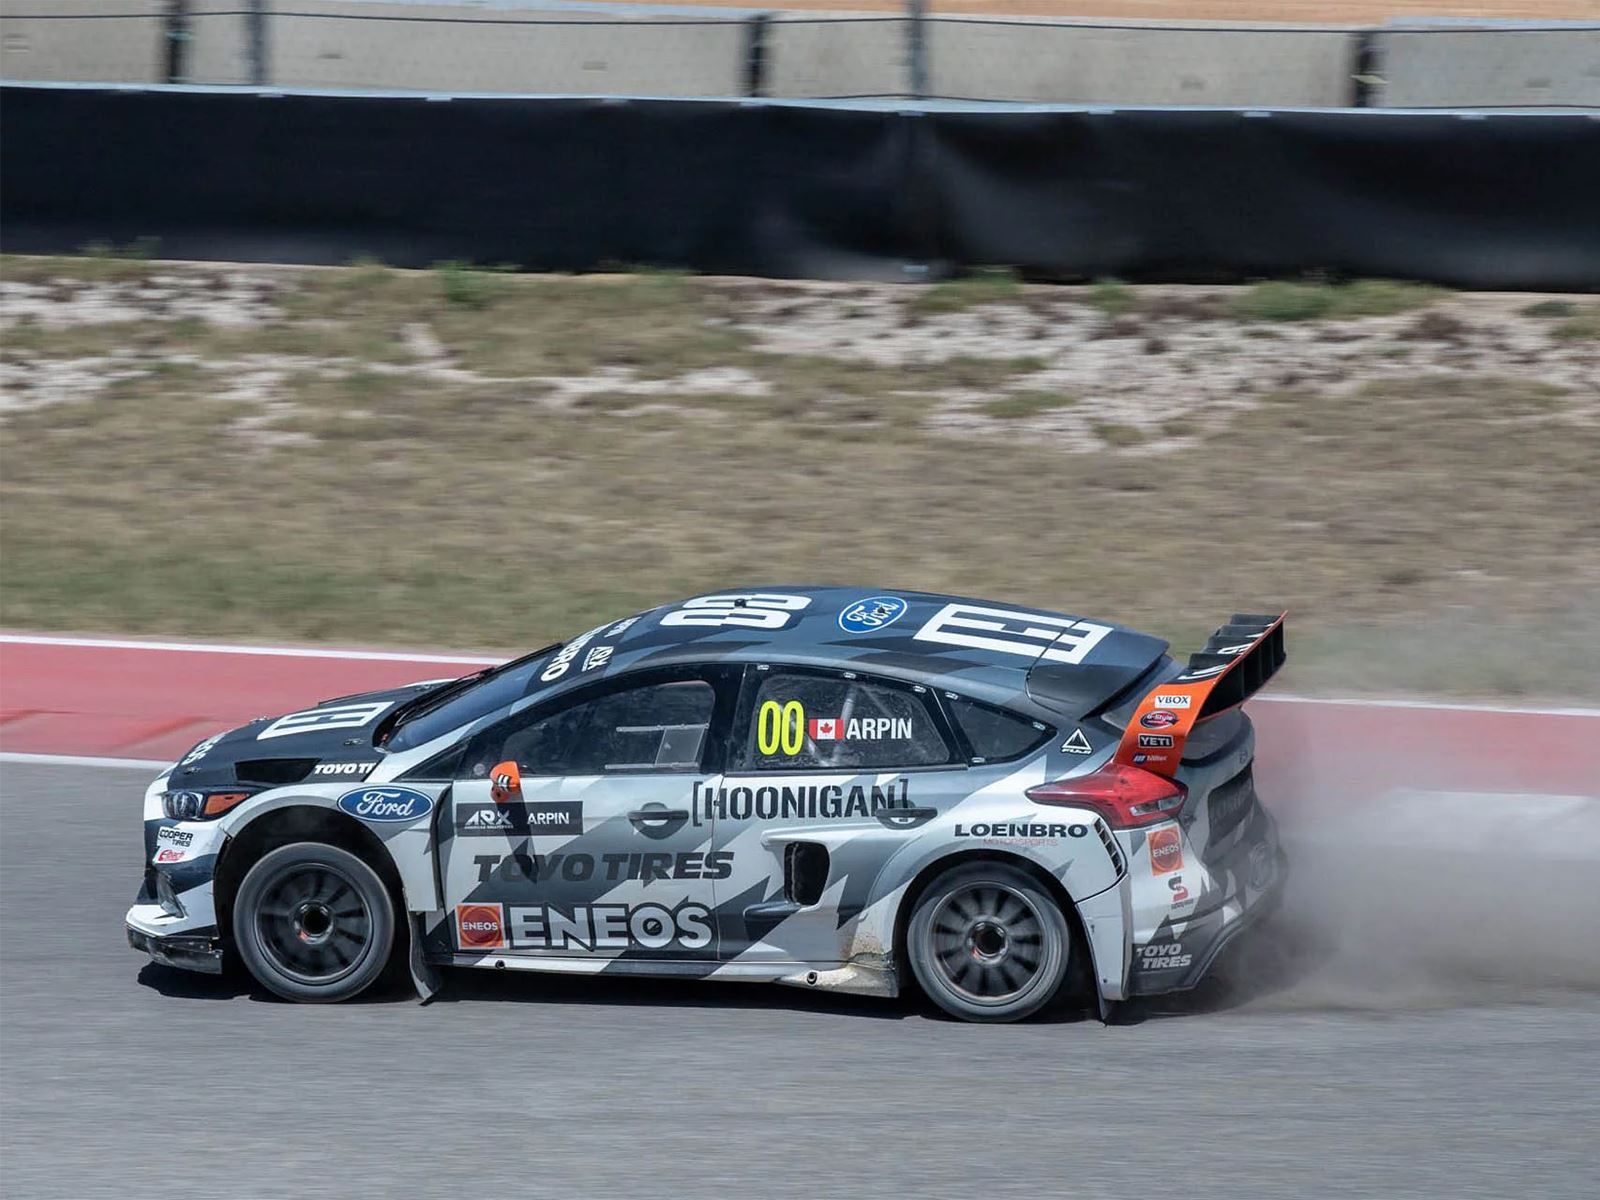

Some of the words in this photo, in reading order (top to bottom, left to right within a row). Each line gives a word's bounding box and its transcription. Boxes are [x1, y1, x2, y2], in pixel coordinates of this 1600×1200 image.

[1157, 696, 1188, 704] VBOX
[757, 700, 805, 756] 00
[846, 717, 912, 740] ARPIN
[1140, 736, 1170, 746] YETI
[314, 763, 357, 774] TOYO
[356, 791, 415, 816] Ford
[527, 812, 570, 825] ARPIN
[159, 829, 194, 841] COOPER
[954, 823, 1089, 838] LOENBRO
[1153, 843, 1180, 858] ENEOS
[473, 853, 595, 882] TOYO
[601, 852, 734, 880] TIRES
[462, 921, 498, 931] ENEOS
[509, 905, 713, 949] ENEOS
[1136, 943, 1182, 957] TOYO
[1142, 954, 1193, 969] TIRES
